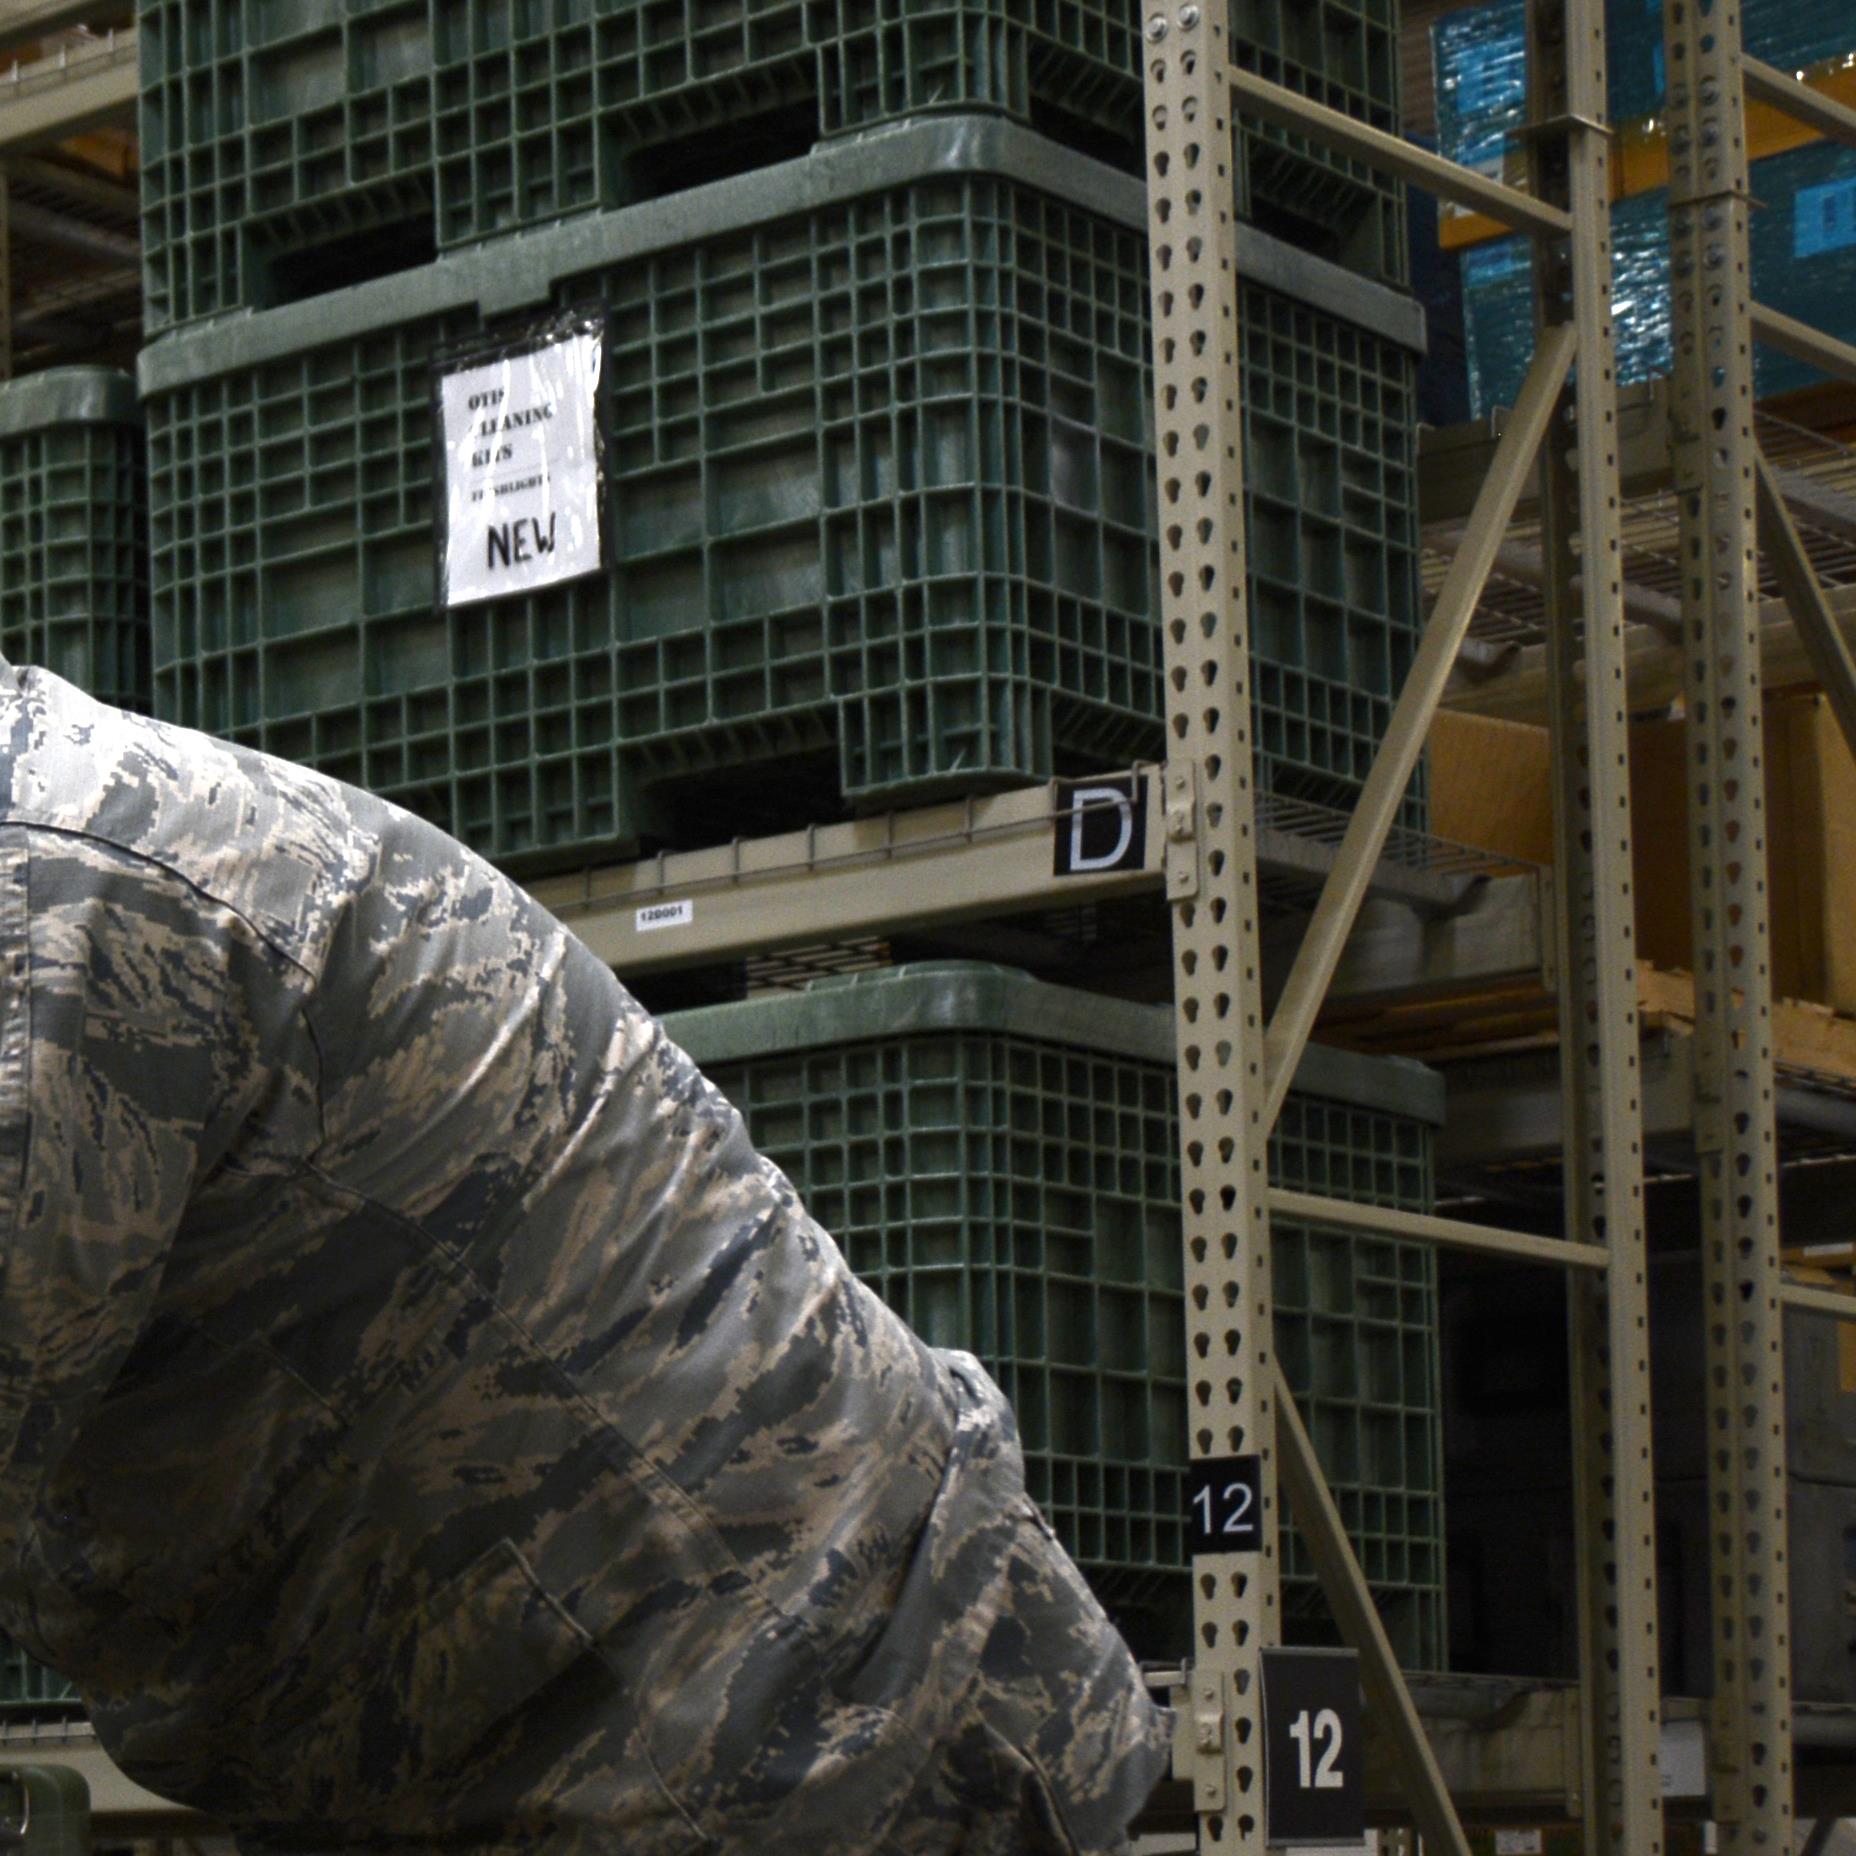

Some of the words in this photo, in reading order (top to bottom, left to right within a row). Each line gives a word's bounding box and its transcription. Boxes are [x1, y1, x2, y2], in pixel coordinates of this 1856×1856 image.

[471, 402, 553, 437] LEANING
[472, 472, 551, 501] FLSHLIGHT
[488, 511, 556, 570] NEW
[1070, 787, 1132, 871] D
[1193, 1482, 1253, 1534] 12
[1289, 1708, 1344, 1788] 12
